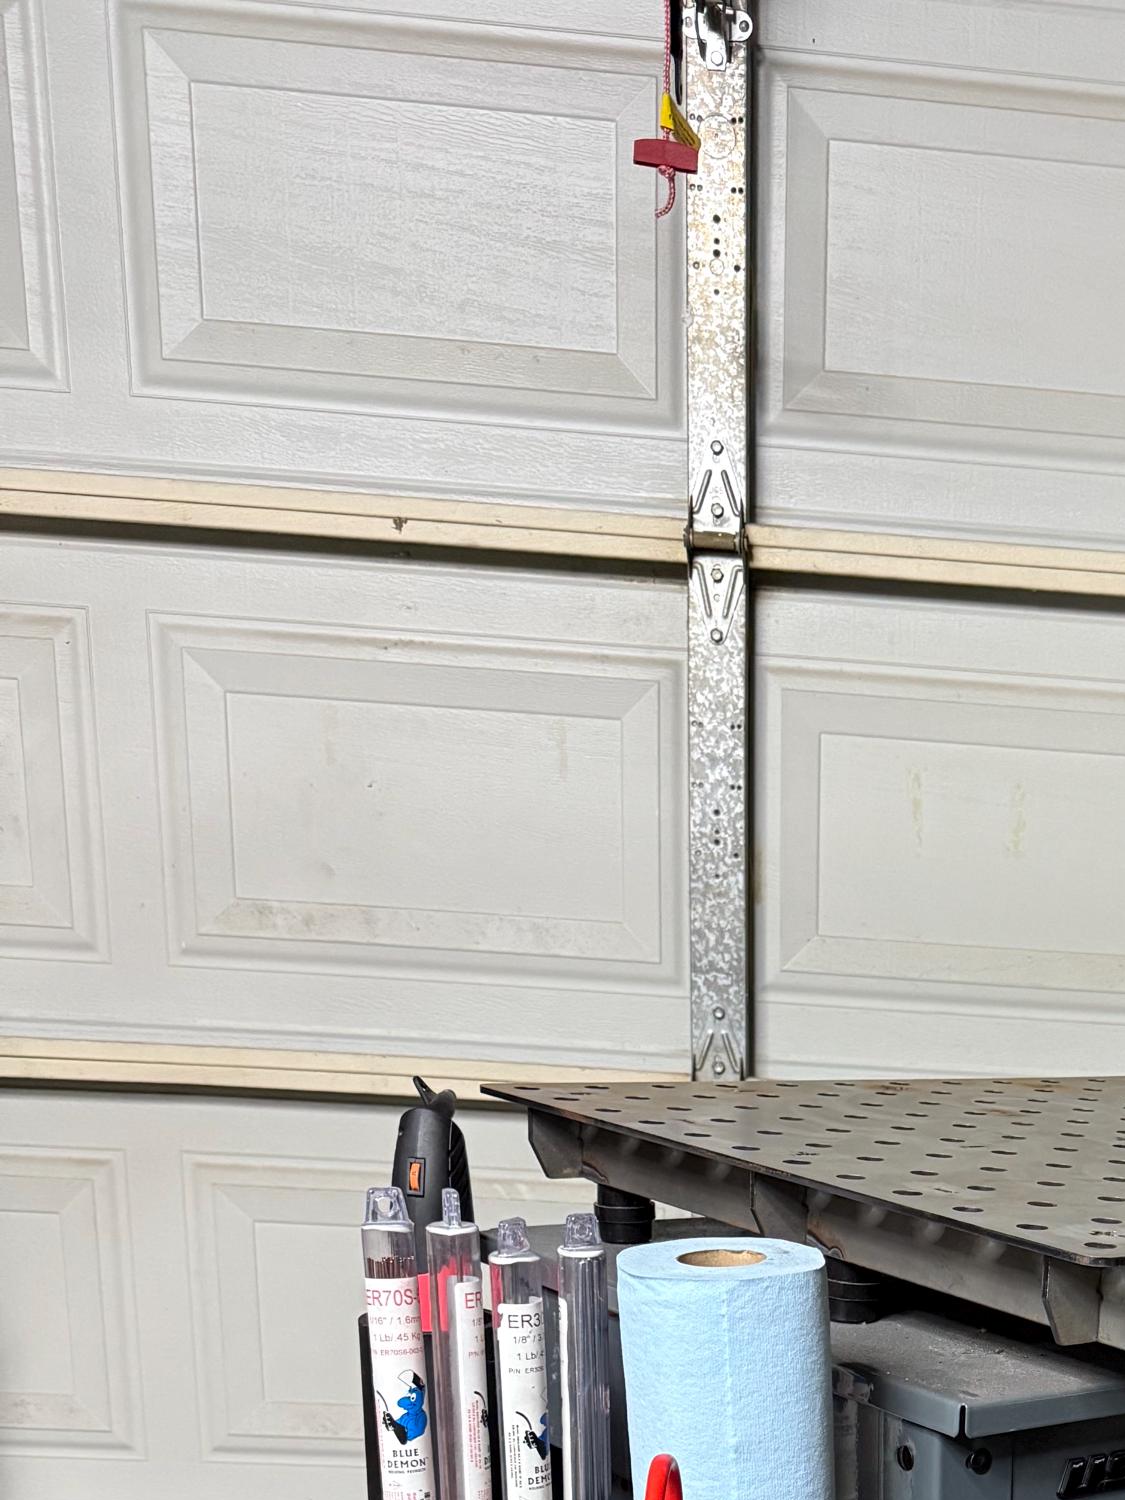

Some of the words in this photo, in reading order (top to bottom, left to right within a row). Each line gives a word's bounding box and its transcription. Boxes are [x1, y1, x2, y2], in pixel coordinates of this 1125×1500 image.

[366, 1288, 421, 1307] ER70S-
[392, 1448, 420, 1458] BLUE
[387, 1457, 427, 1469] DEMON
[534, 1462, 551, 1474] BLU
